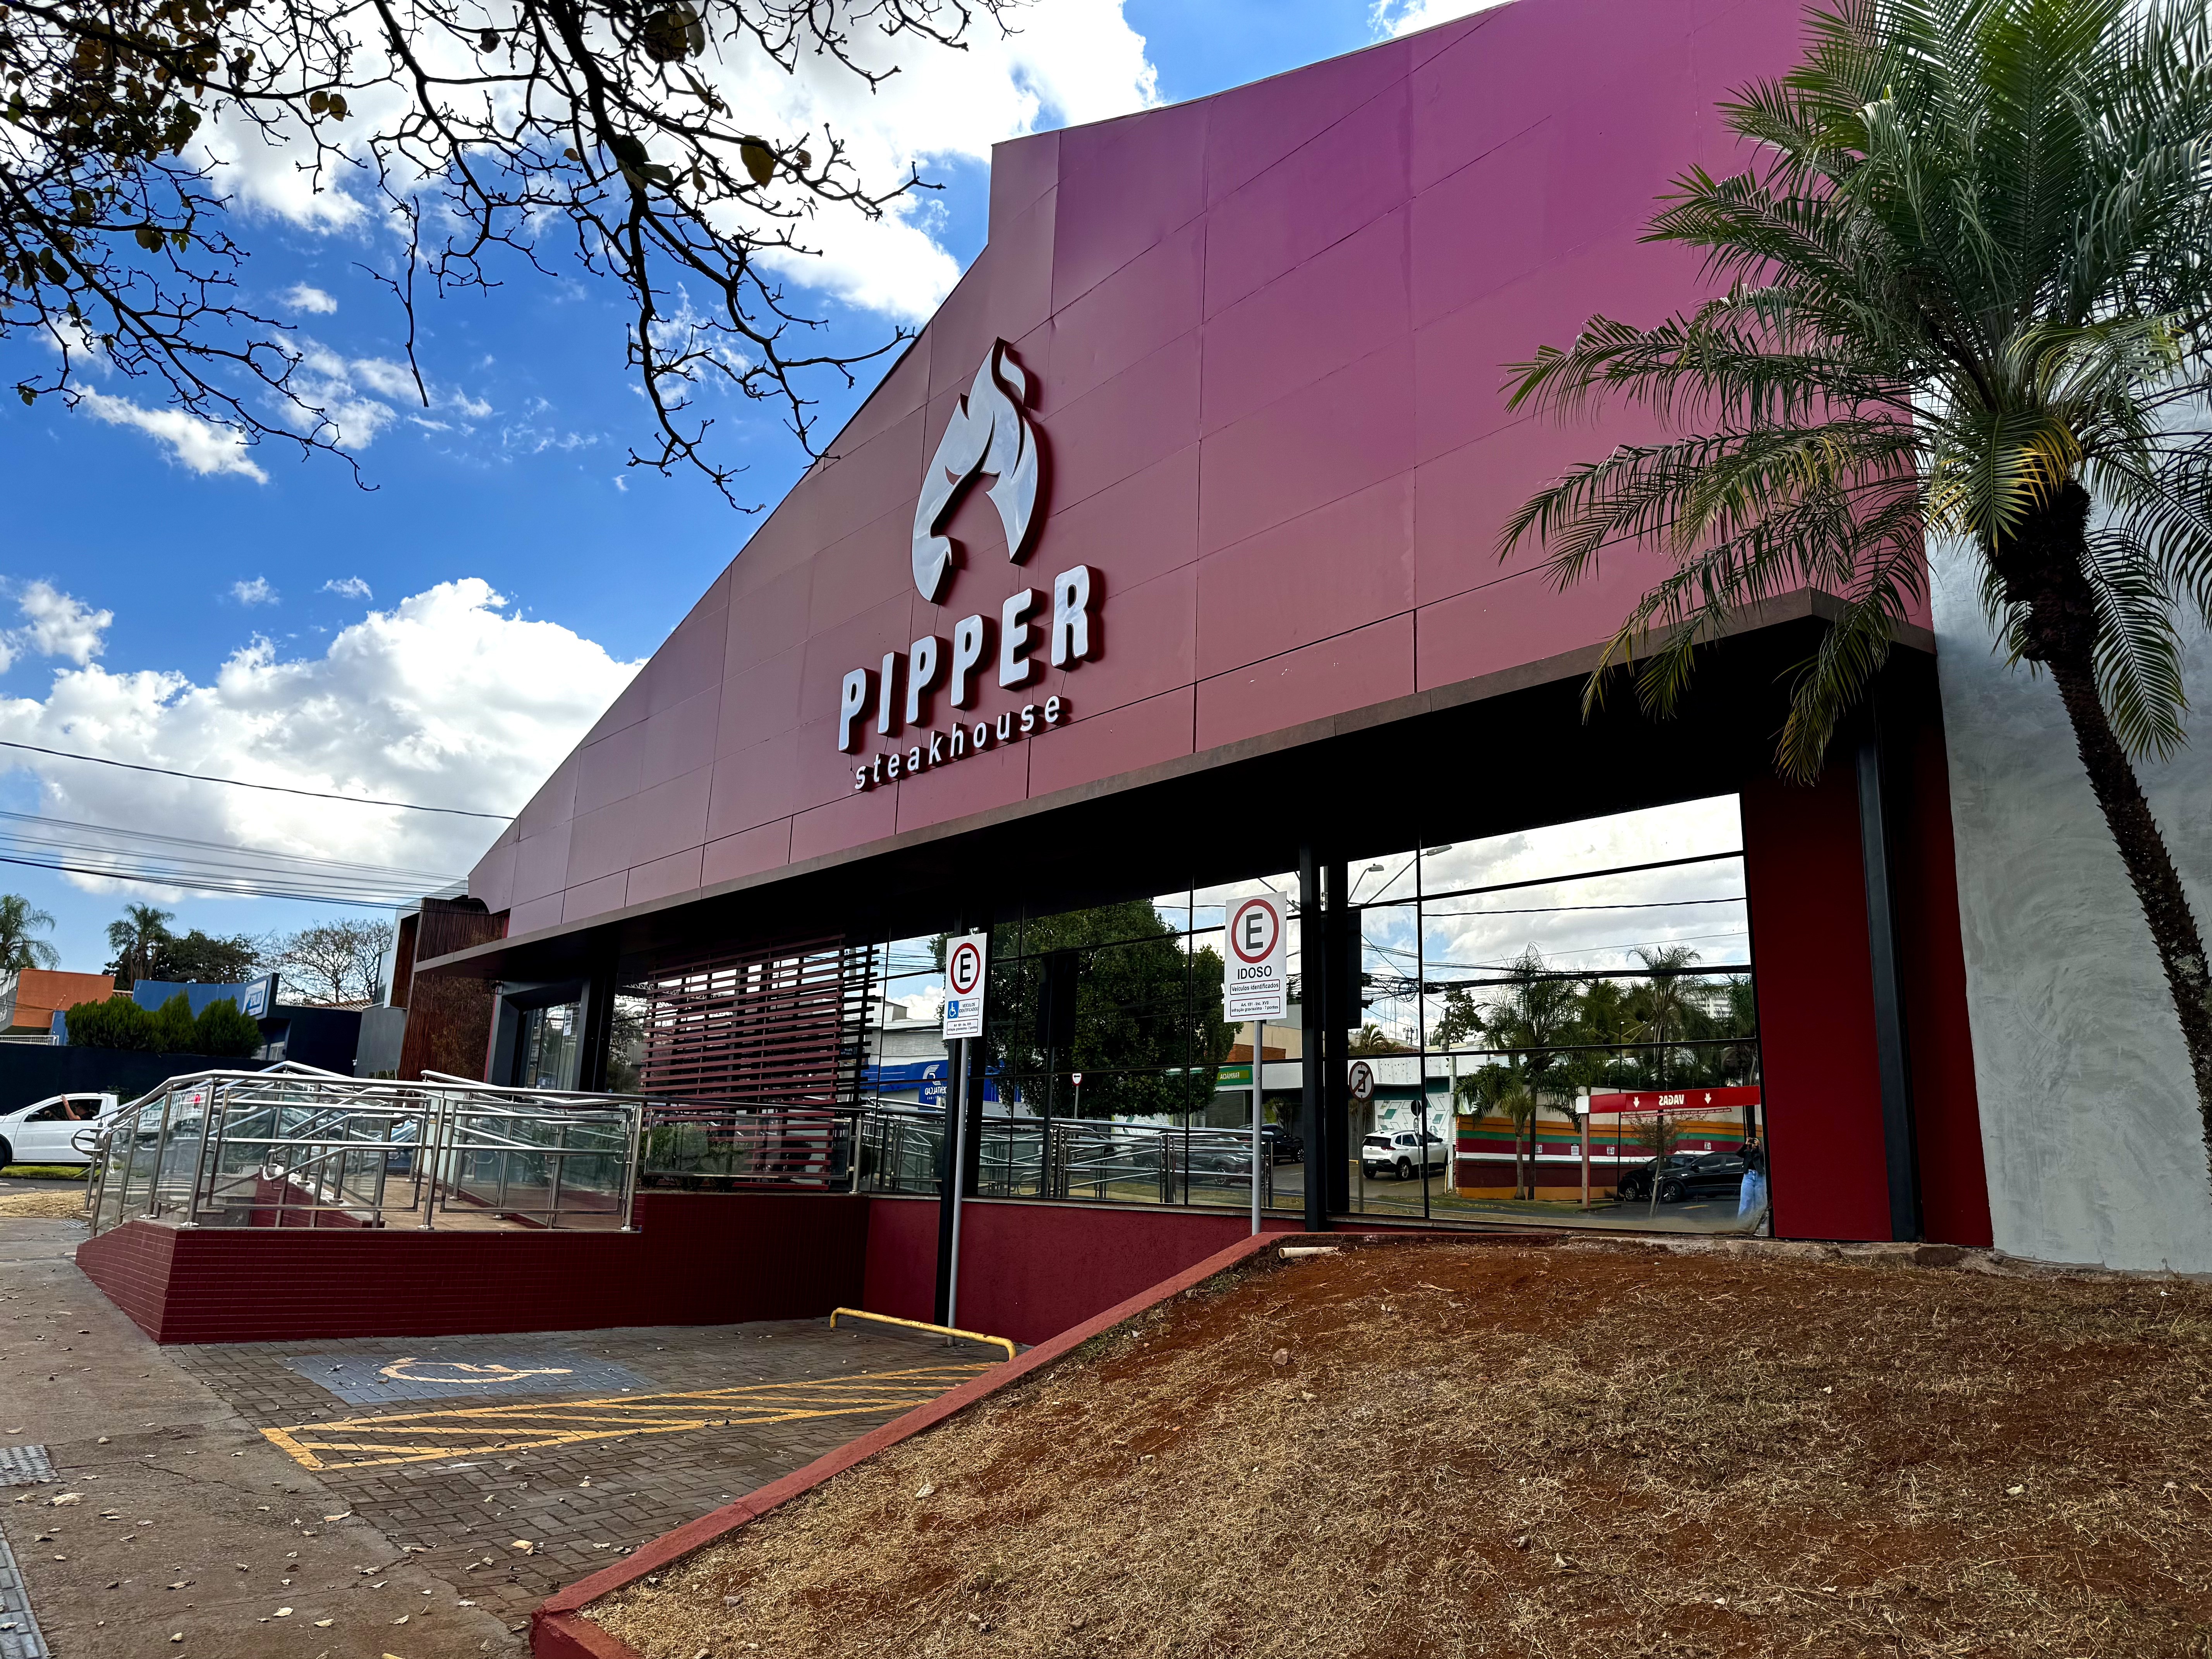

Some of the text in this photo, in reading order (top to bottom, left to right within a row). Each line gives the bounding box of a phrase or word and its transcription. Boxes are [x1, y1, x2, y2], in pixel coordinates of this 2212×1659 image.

[838, 564, 1096, 753] PIPPER
[855, 695, 1065, 790] steakhouse
[1246, 913, 1264, 950] E
[959, 953, 972, 983] E
[1238, 965, 1272, 979] IDOSO
